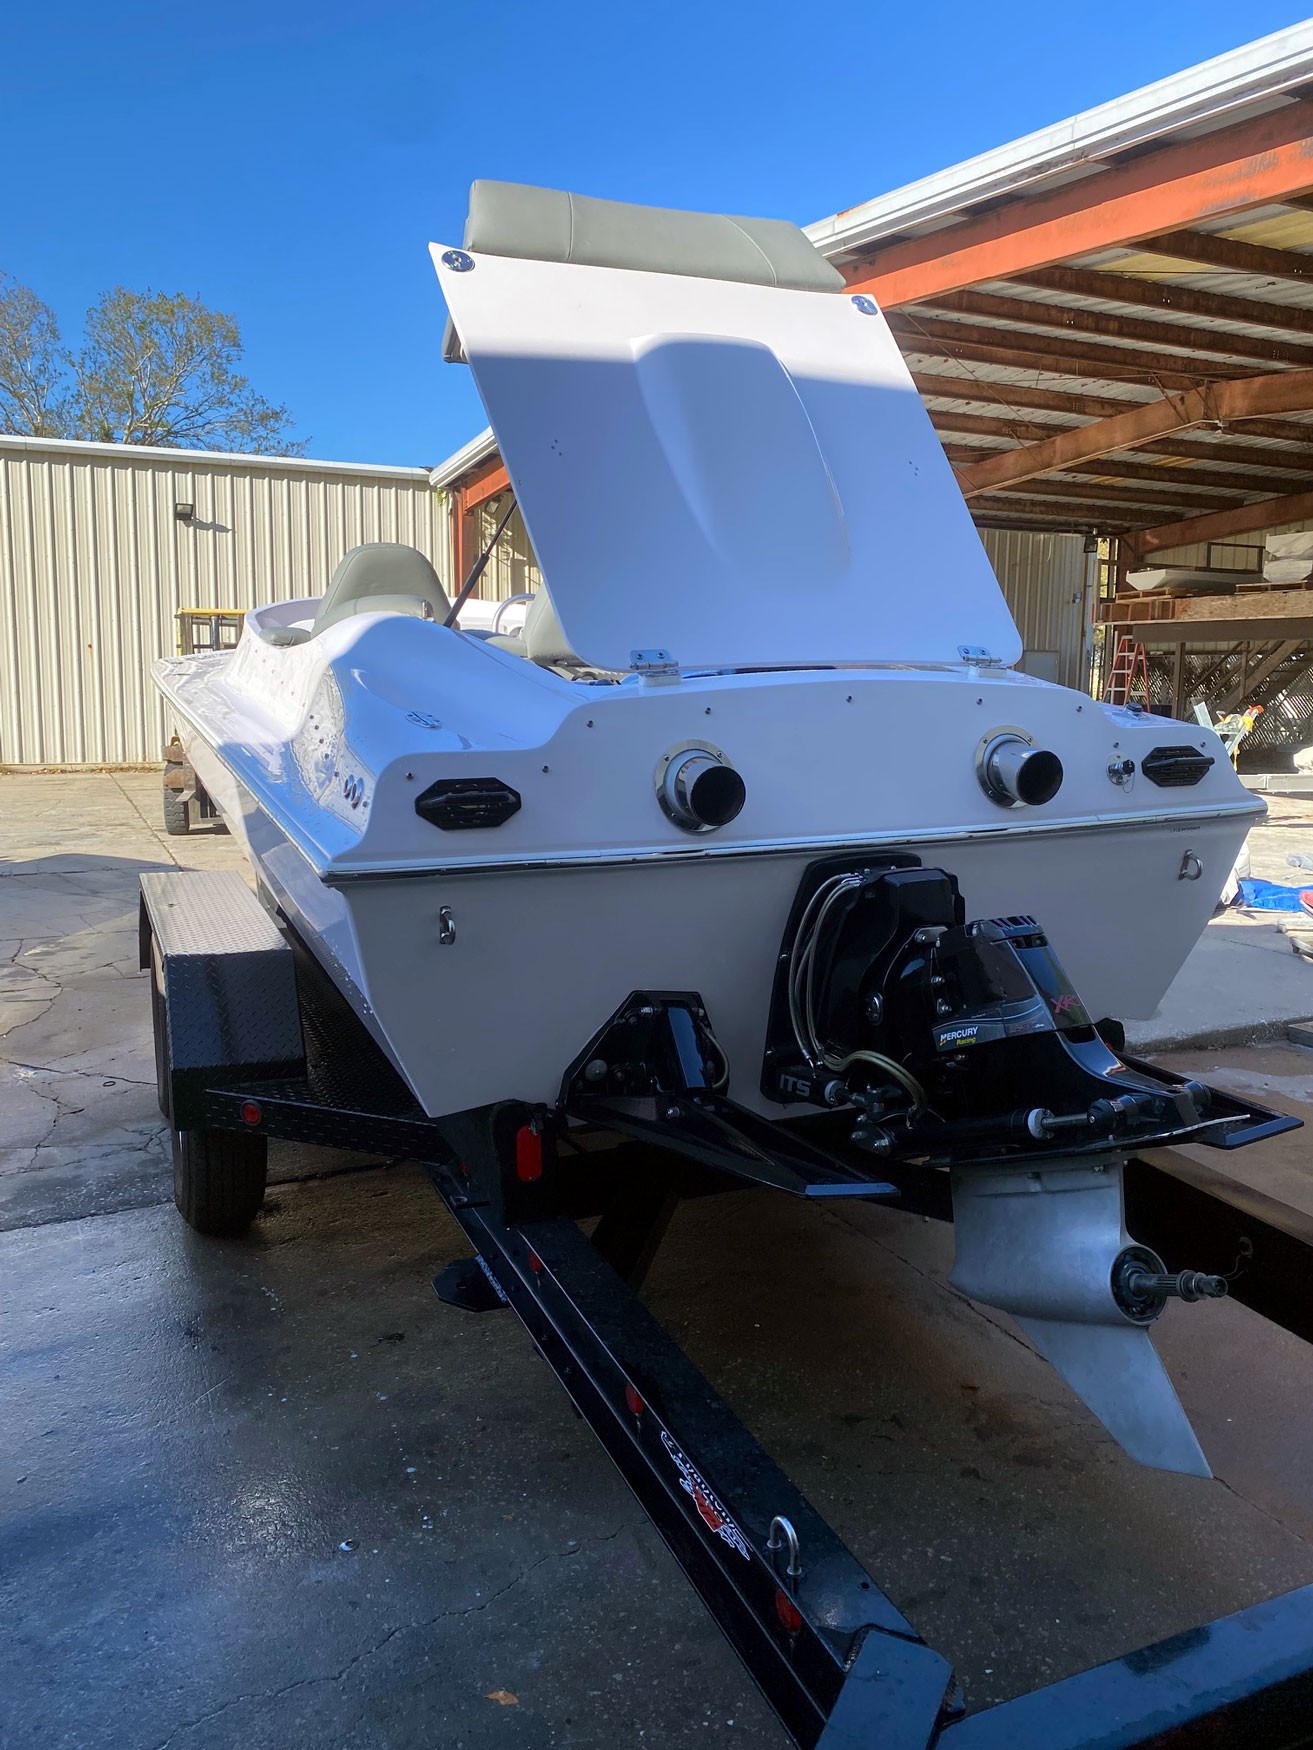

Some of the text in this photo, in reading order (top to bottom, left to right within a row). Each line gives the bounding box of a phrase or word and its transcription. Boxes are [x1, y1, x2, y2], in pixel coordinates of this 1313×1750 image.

[1050, 994, 1080, 1013] XR
[940, 1026, 979, 1042] MERCURY
[956, 1037, 977, 1047] Racing
[780, 1074, 812, 1097] ITS
